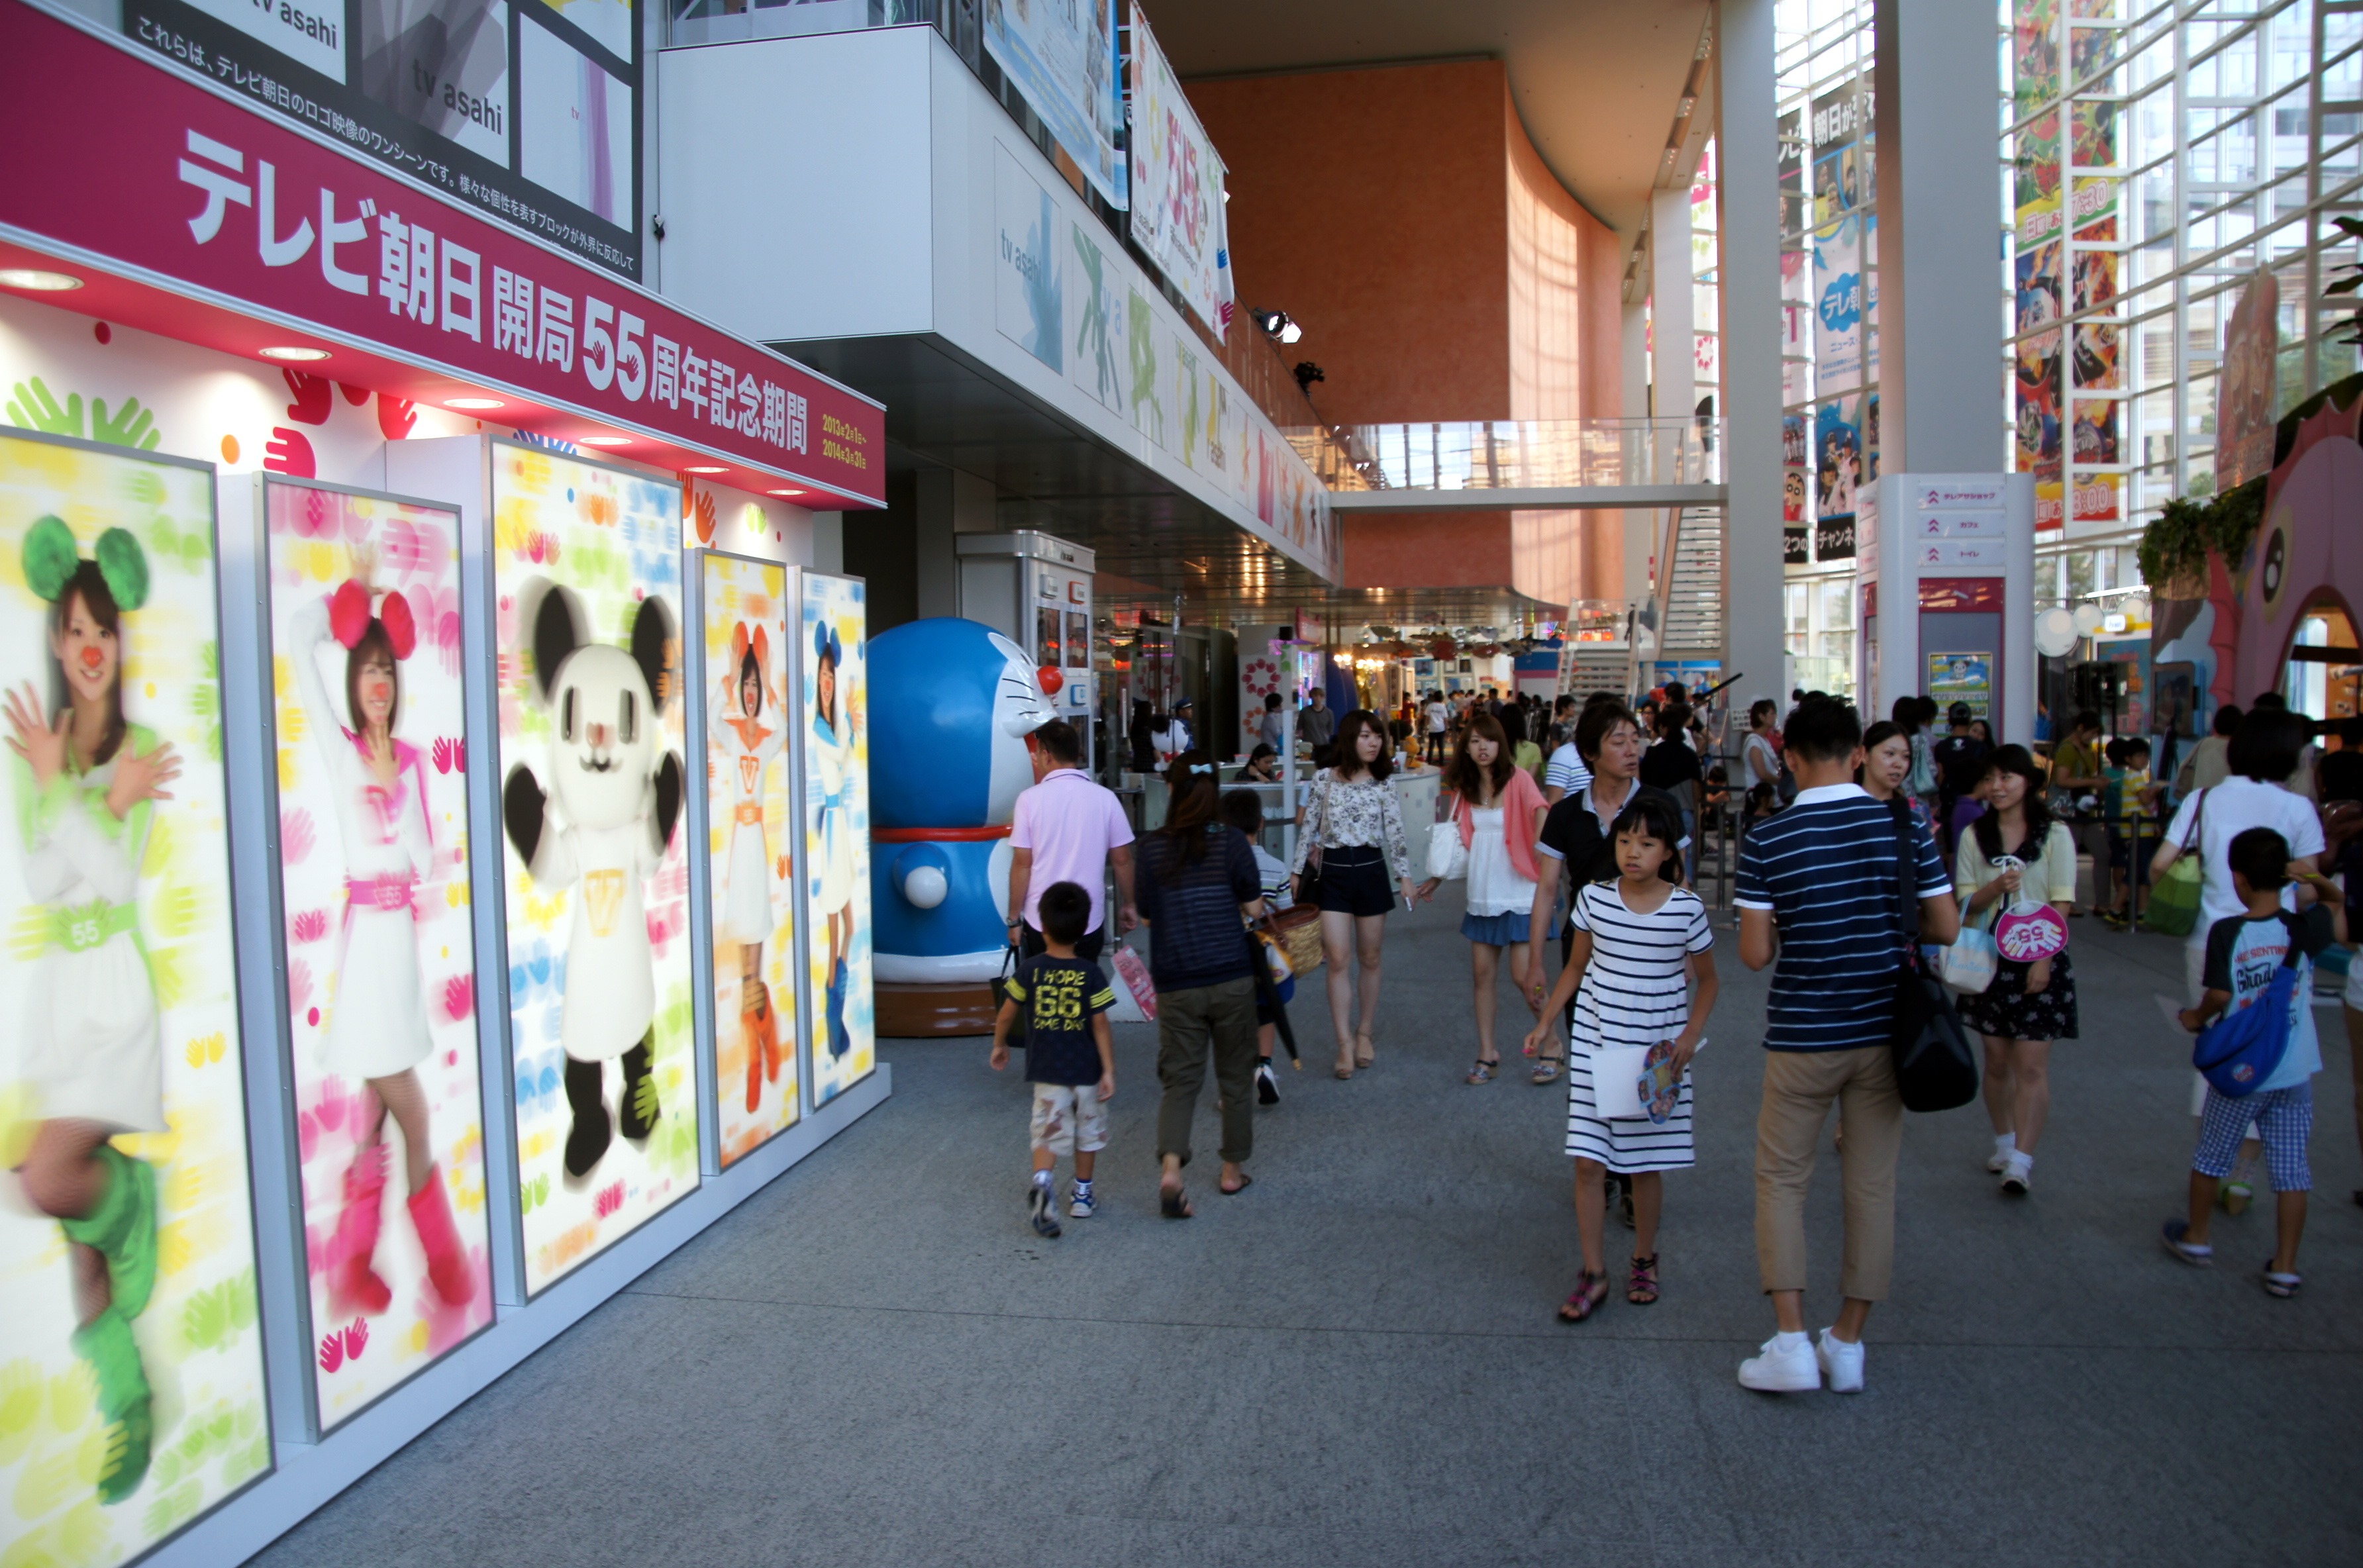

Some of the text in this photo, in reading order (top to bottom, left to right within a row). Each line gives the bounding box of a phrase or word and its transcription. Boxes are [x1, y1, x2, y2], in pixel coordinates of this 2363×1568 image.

[280, 2, 337, 50] asahi
[413, 58, 502, 135] tv asahi
[1001, 228, 1013, 263] tv
[71, 918, 100, 947] 55
[1033, 967, 1086, 986] I HOPE
[1034, 985, 1081, 1018] 66
